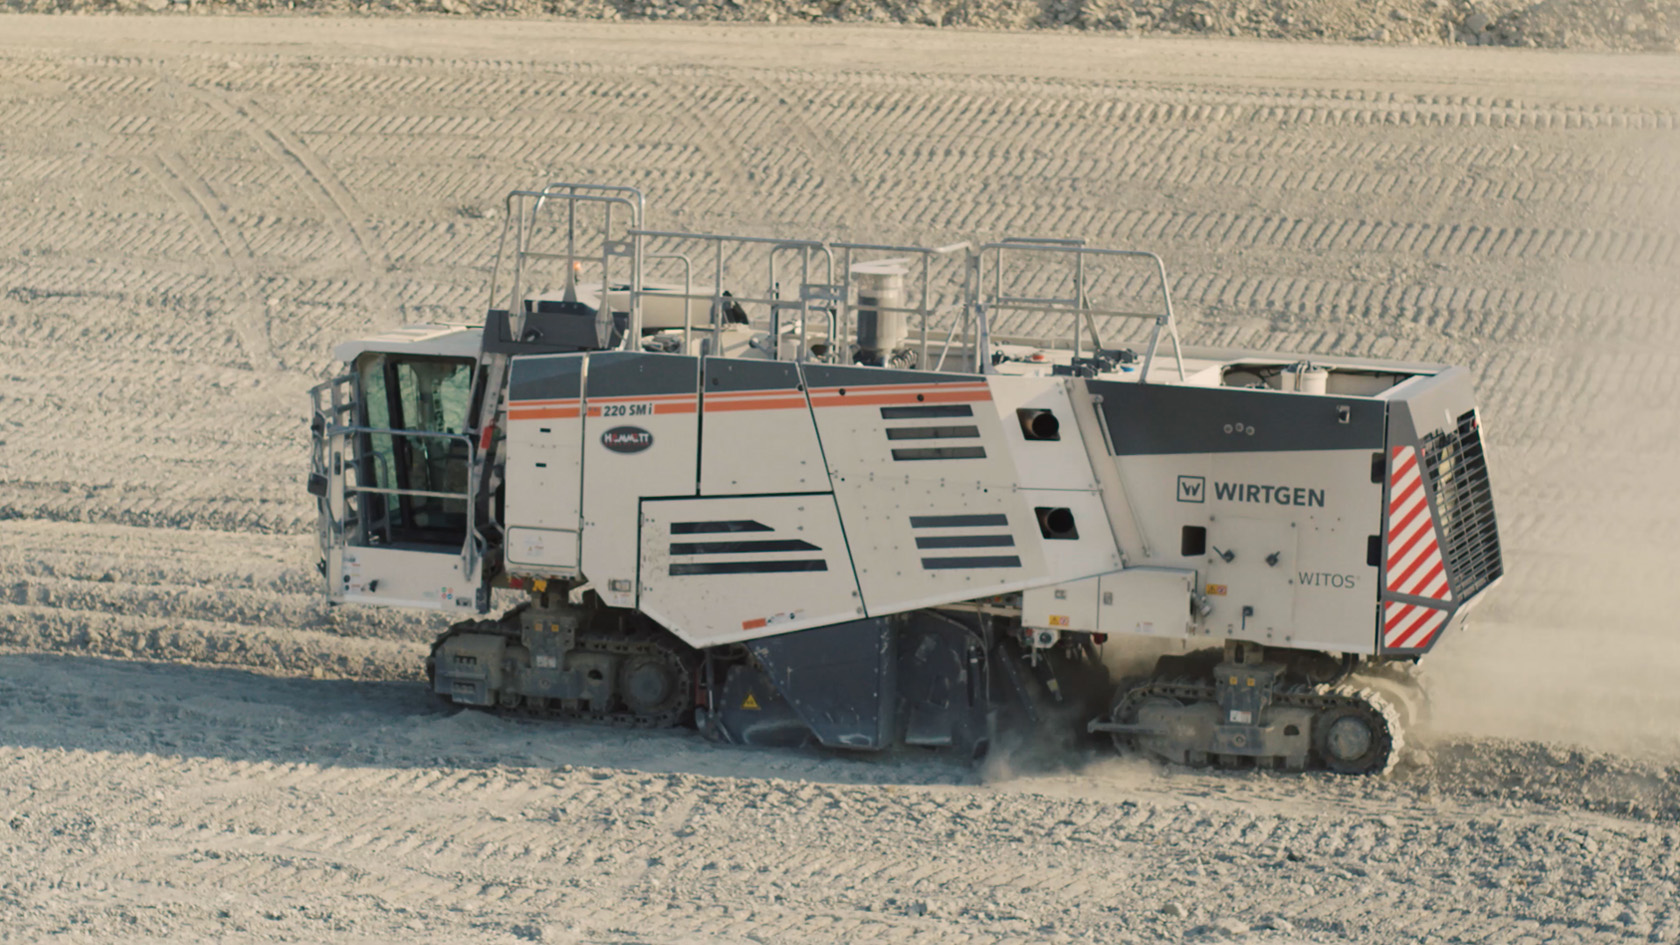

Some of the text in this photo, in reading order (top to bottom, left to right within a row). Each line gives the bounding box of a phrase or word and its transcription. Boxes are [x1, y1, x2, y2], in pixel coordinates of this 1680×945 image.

[603, 405, 626, 417] 220
[1214, 481, 1325, 508] WIRTGEN
[1298, 571, 1356, 589] WITOS
